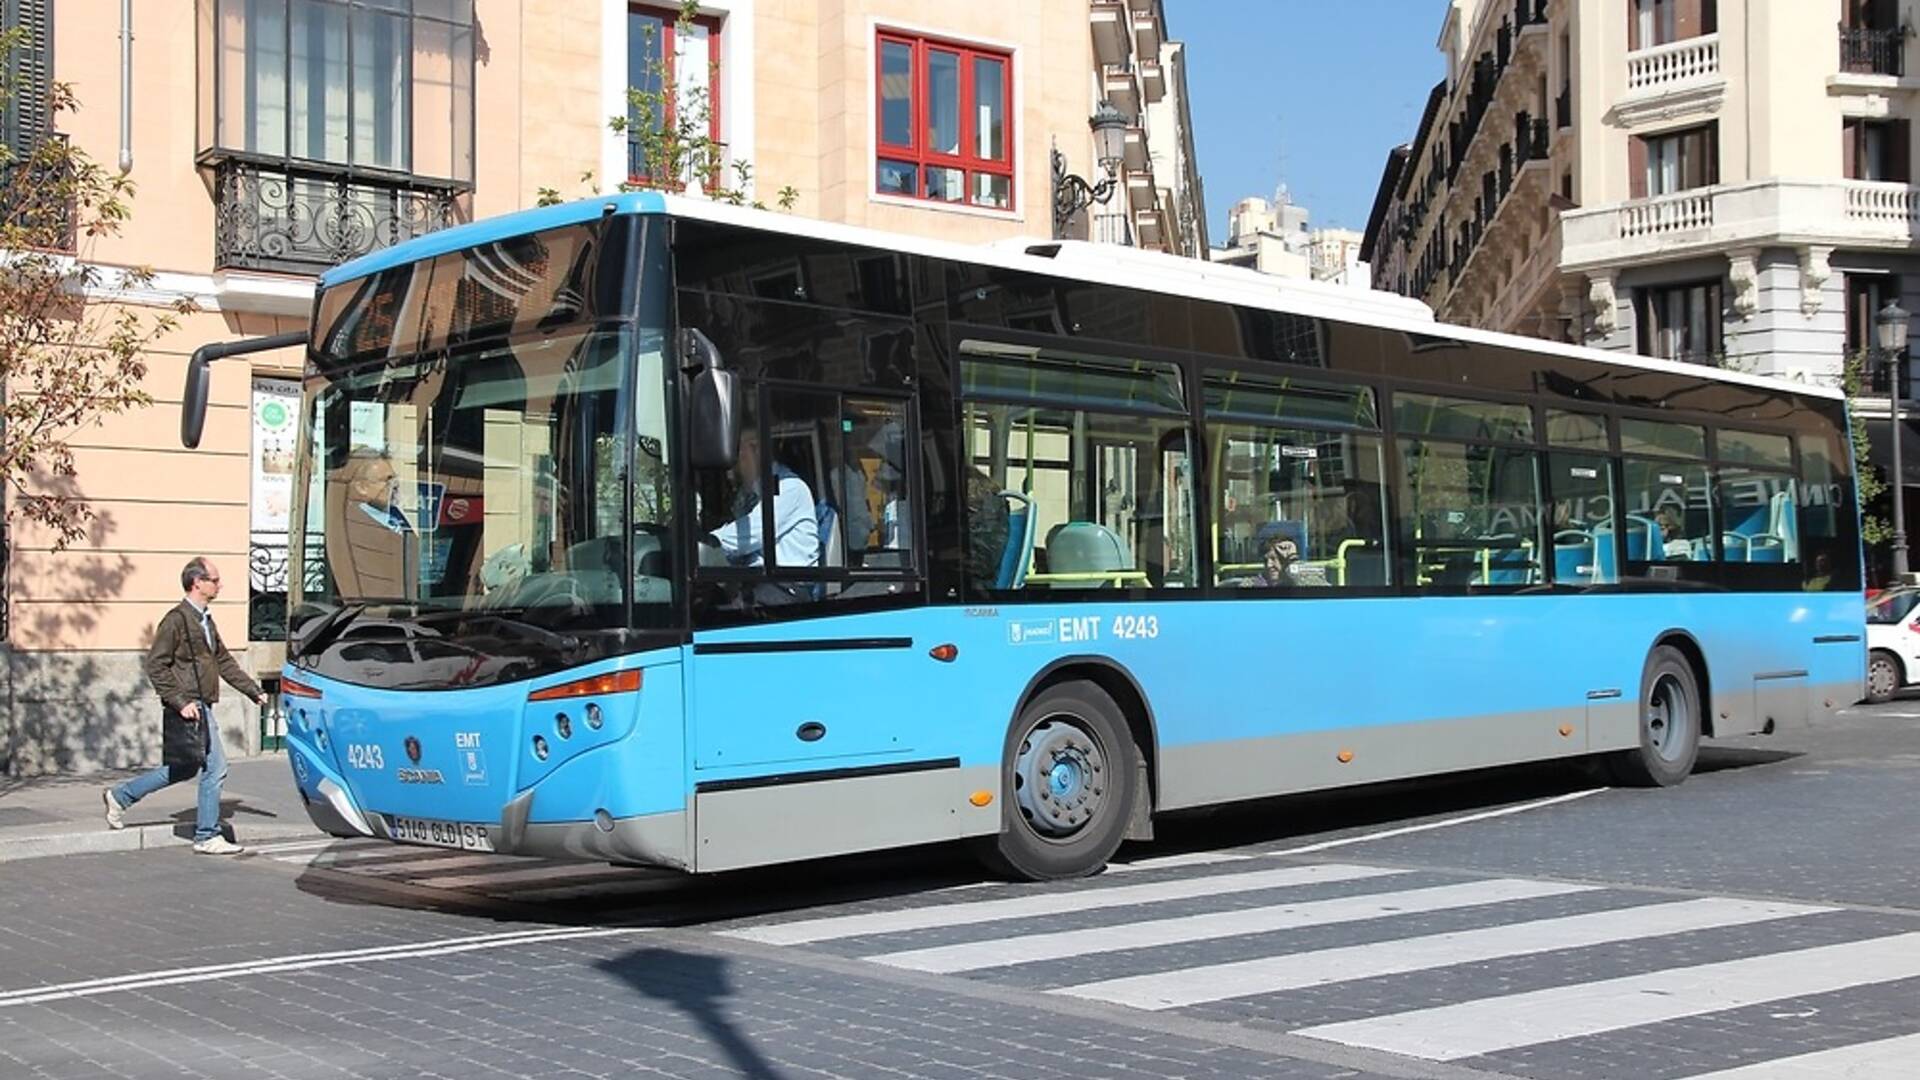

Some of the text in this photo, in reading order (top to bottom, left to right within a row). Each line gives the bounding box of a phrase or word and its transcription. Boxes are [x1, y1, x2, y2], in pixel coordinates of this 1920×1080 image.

[1059, 617, 1101, 642] EMT
[1112, 615, 1159, 639] 4243
[455, 732, 481, 748] EMT
[348, 744, 384, 769] 4243
[399, 768, 445, 784] SCANIA
[396, 818, 427, 840] 5140
[431, 823, 456, 844] GLD
